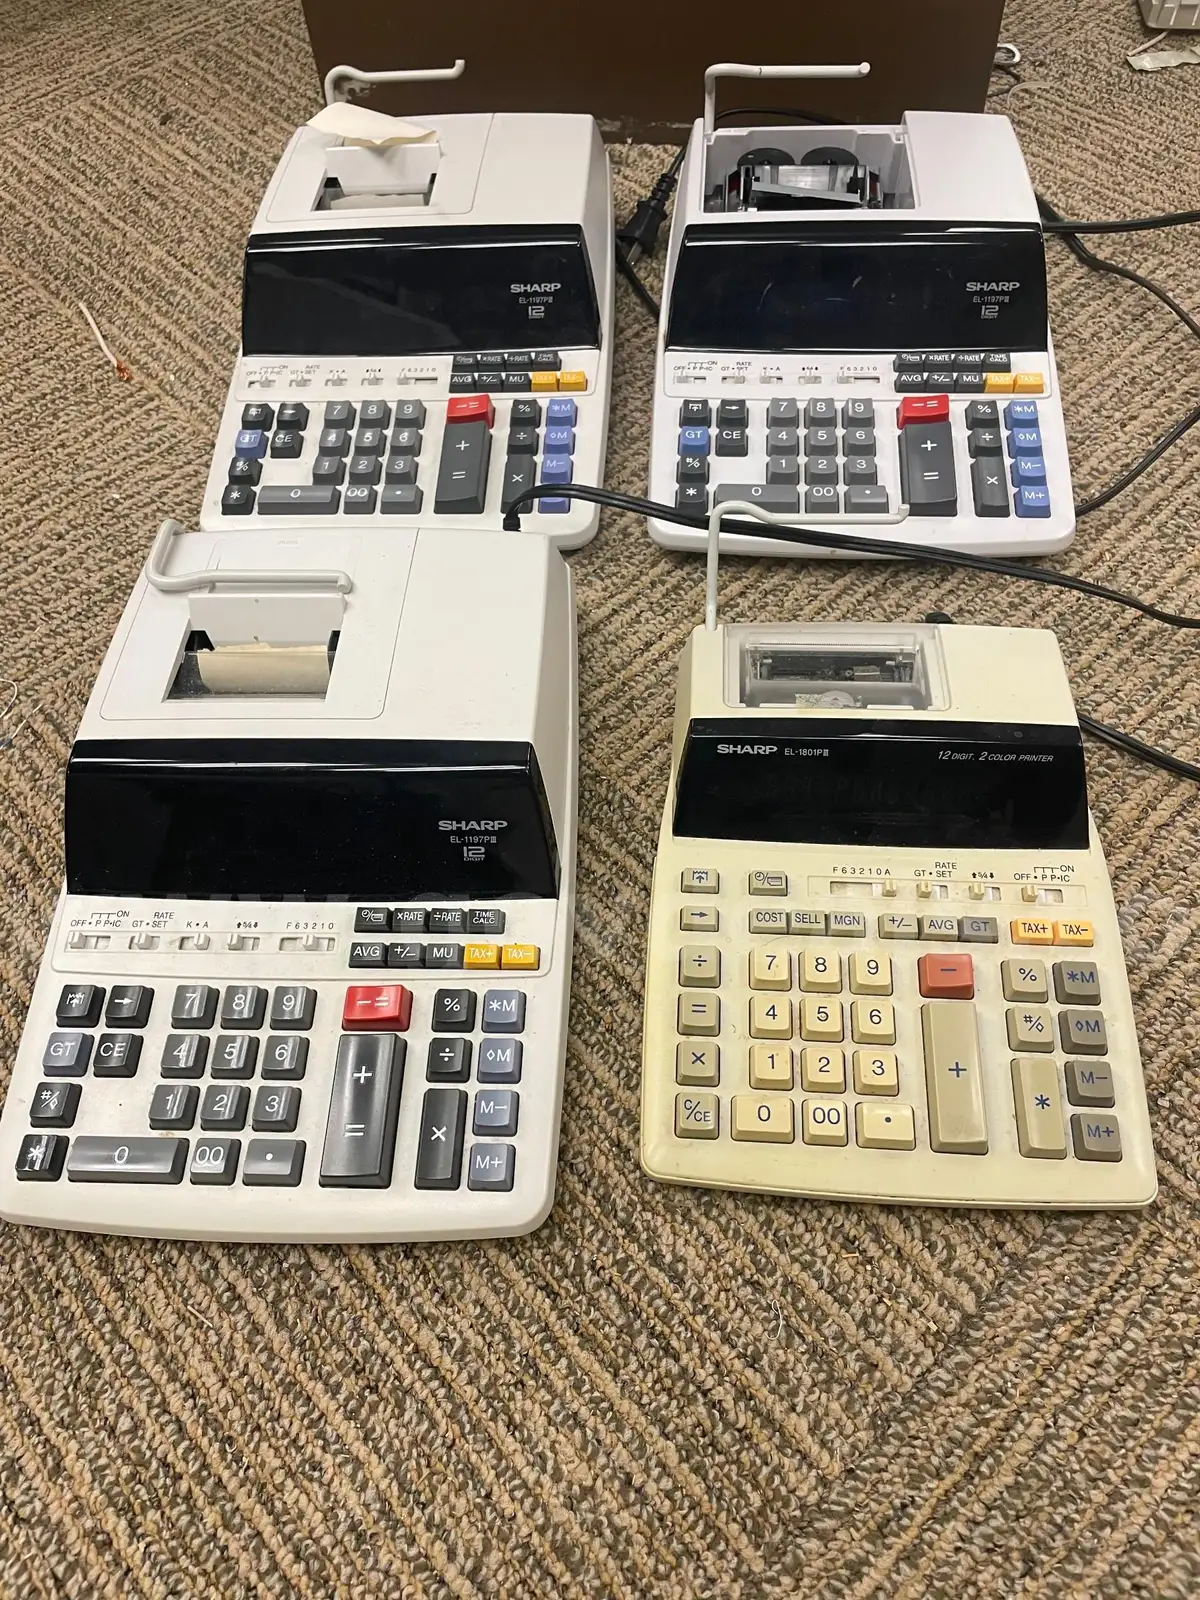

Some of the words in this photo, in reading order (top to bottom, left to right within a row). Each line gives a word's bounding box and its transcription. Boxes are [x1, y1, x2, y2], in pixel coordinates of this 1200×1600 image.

[510, 283, 561, 293] SHARP
[966, 282, 1020, 292] SHARP
[900, 374, 922, 382] AVG
[333, 405, 342, 415] 7
[367, 405, 377, 415] 8
[403, 404, 413, 414] 9
[518, 404, 530, 412] %
[778, 402, 788, 412] 7
[816, 402, 826, 412] 8
[854, 402, 864, 412] 9
[977, 404, 992, 414] %
[240, 434, 258, 443] GT
[275, 434, 293, 443] CE
[327, 433, 337, 443] 4
[363, 433, 373, 442] 5
[399, 432, 408, 442] 6
[685, 430, 703, 439] GT
[722, 430, 741, 439] CE
[778, 431, 788, 440] 4
[817, 431, 827, 440] 5
[856, 430, 866, 440] 6
[323, 462, 329, 470] 1
[358, 460, 368, 469] 2
[394, 460, 404, 469] 3
[780, 459, 786, 468] 1
[818, 459, 827, 468] 2
[856, 459, 866, 468] 3
[290, 488, 300, 498] 0
[347, 487, 368, 497] 00
[751, 486, 762, 496] 0
[812, 486, 834, 496] 00
[716, 744, 778, 755] SHARP
[938, 750, 952, 760] 12
[979, 752, 988, 760] 2
[988, 754, 1017, 762] COLOR
[1018, 754, 1054, 762] PRINTER
[438, 820, 508, 831] SHARP
[463, 846, 486, 858] 12
[935, 862, 958, 870] RATE
[1060, 864, 1075, 872] ON
[936, 870, 952, 878] SET
[1014, 872, 1031, 880] OFF
[116, 910, 130, 918] ON
[154, 912, 175, 920] RATE
[756, 911, 784, 922] COST
[794, 912, 821, 924] SELL
[132, 920, 144, 928] GT
[152, 920, 168, 928] SET
[834, 915, 861, 926] MGN
[928, 918, 954, 930] AVG
[970, 921, 989, 932] GT
[1021, 922, 1049, 934] TAX+
[1062, 923, 1089, 935] TAX-
[353, 946, 380, 957] AVG
[432, 948, 453, 958] MU
[468, 948, 494, 959] TAX+
[506, 948, 532, 959] TAX-
[765, 954, 777, 970] 7
[814, 956, 828, 972] 8
[867, 960, 879, 976] 9
[1018, 967, 1038, 982] %
[184, 994, 198, 1010] 7
[232, 994, 246, 1010] 8
[282, 994, 296, 1011] 9
[444, 998, 460, 1012] %
[765, 1004, 778, 1020] 4
[816, 1006, 829, 1022] 5
[869, 1008, 882, 1024] 6
[50, 1042, 75, 1057] GT
[100, 1042, 127, 1057] CE
[173, 1043, 188, 1059] 4
[224, 1044, 239, 1060] 5
[275, 1044, 289, 1060] 6
[768, 1054, 776, 1070] 1
[818, 1056, 830, 1072] 2
[872, 1060, 885, 1076] 3
[165, 1094, 174, 1110] 1
[213, 1094, 228, 1111] 2
[265, 1096, 280, 1112] 3
[684, 1099, 711, 1122] C/CE
[757, 1104, 771, 1122] 0
[812, 1107, 841, 1124] 00
[1086, 1124, 1115, 1138] M+
[114, 1146, 130, 1164] 0
[195, 1146, 224, 1164] 00
[476, 1155, 503, 1169] M+
